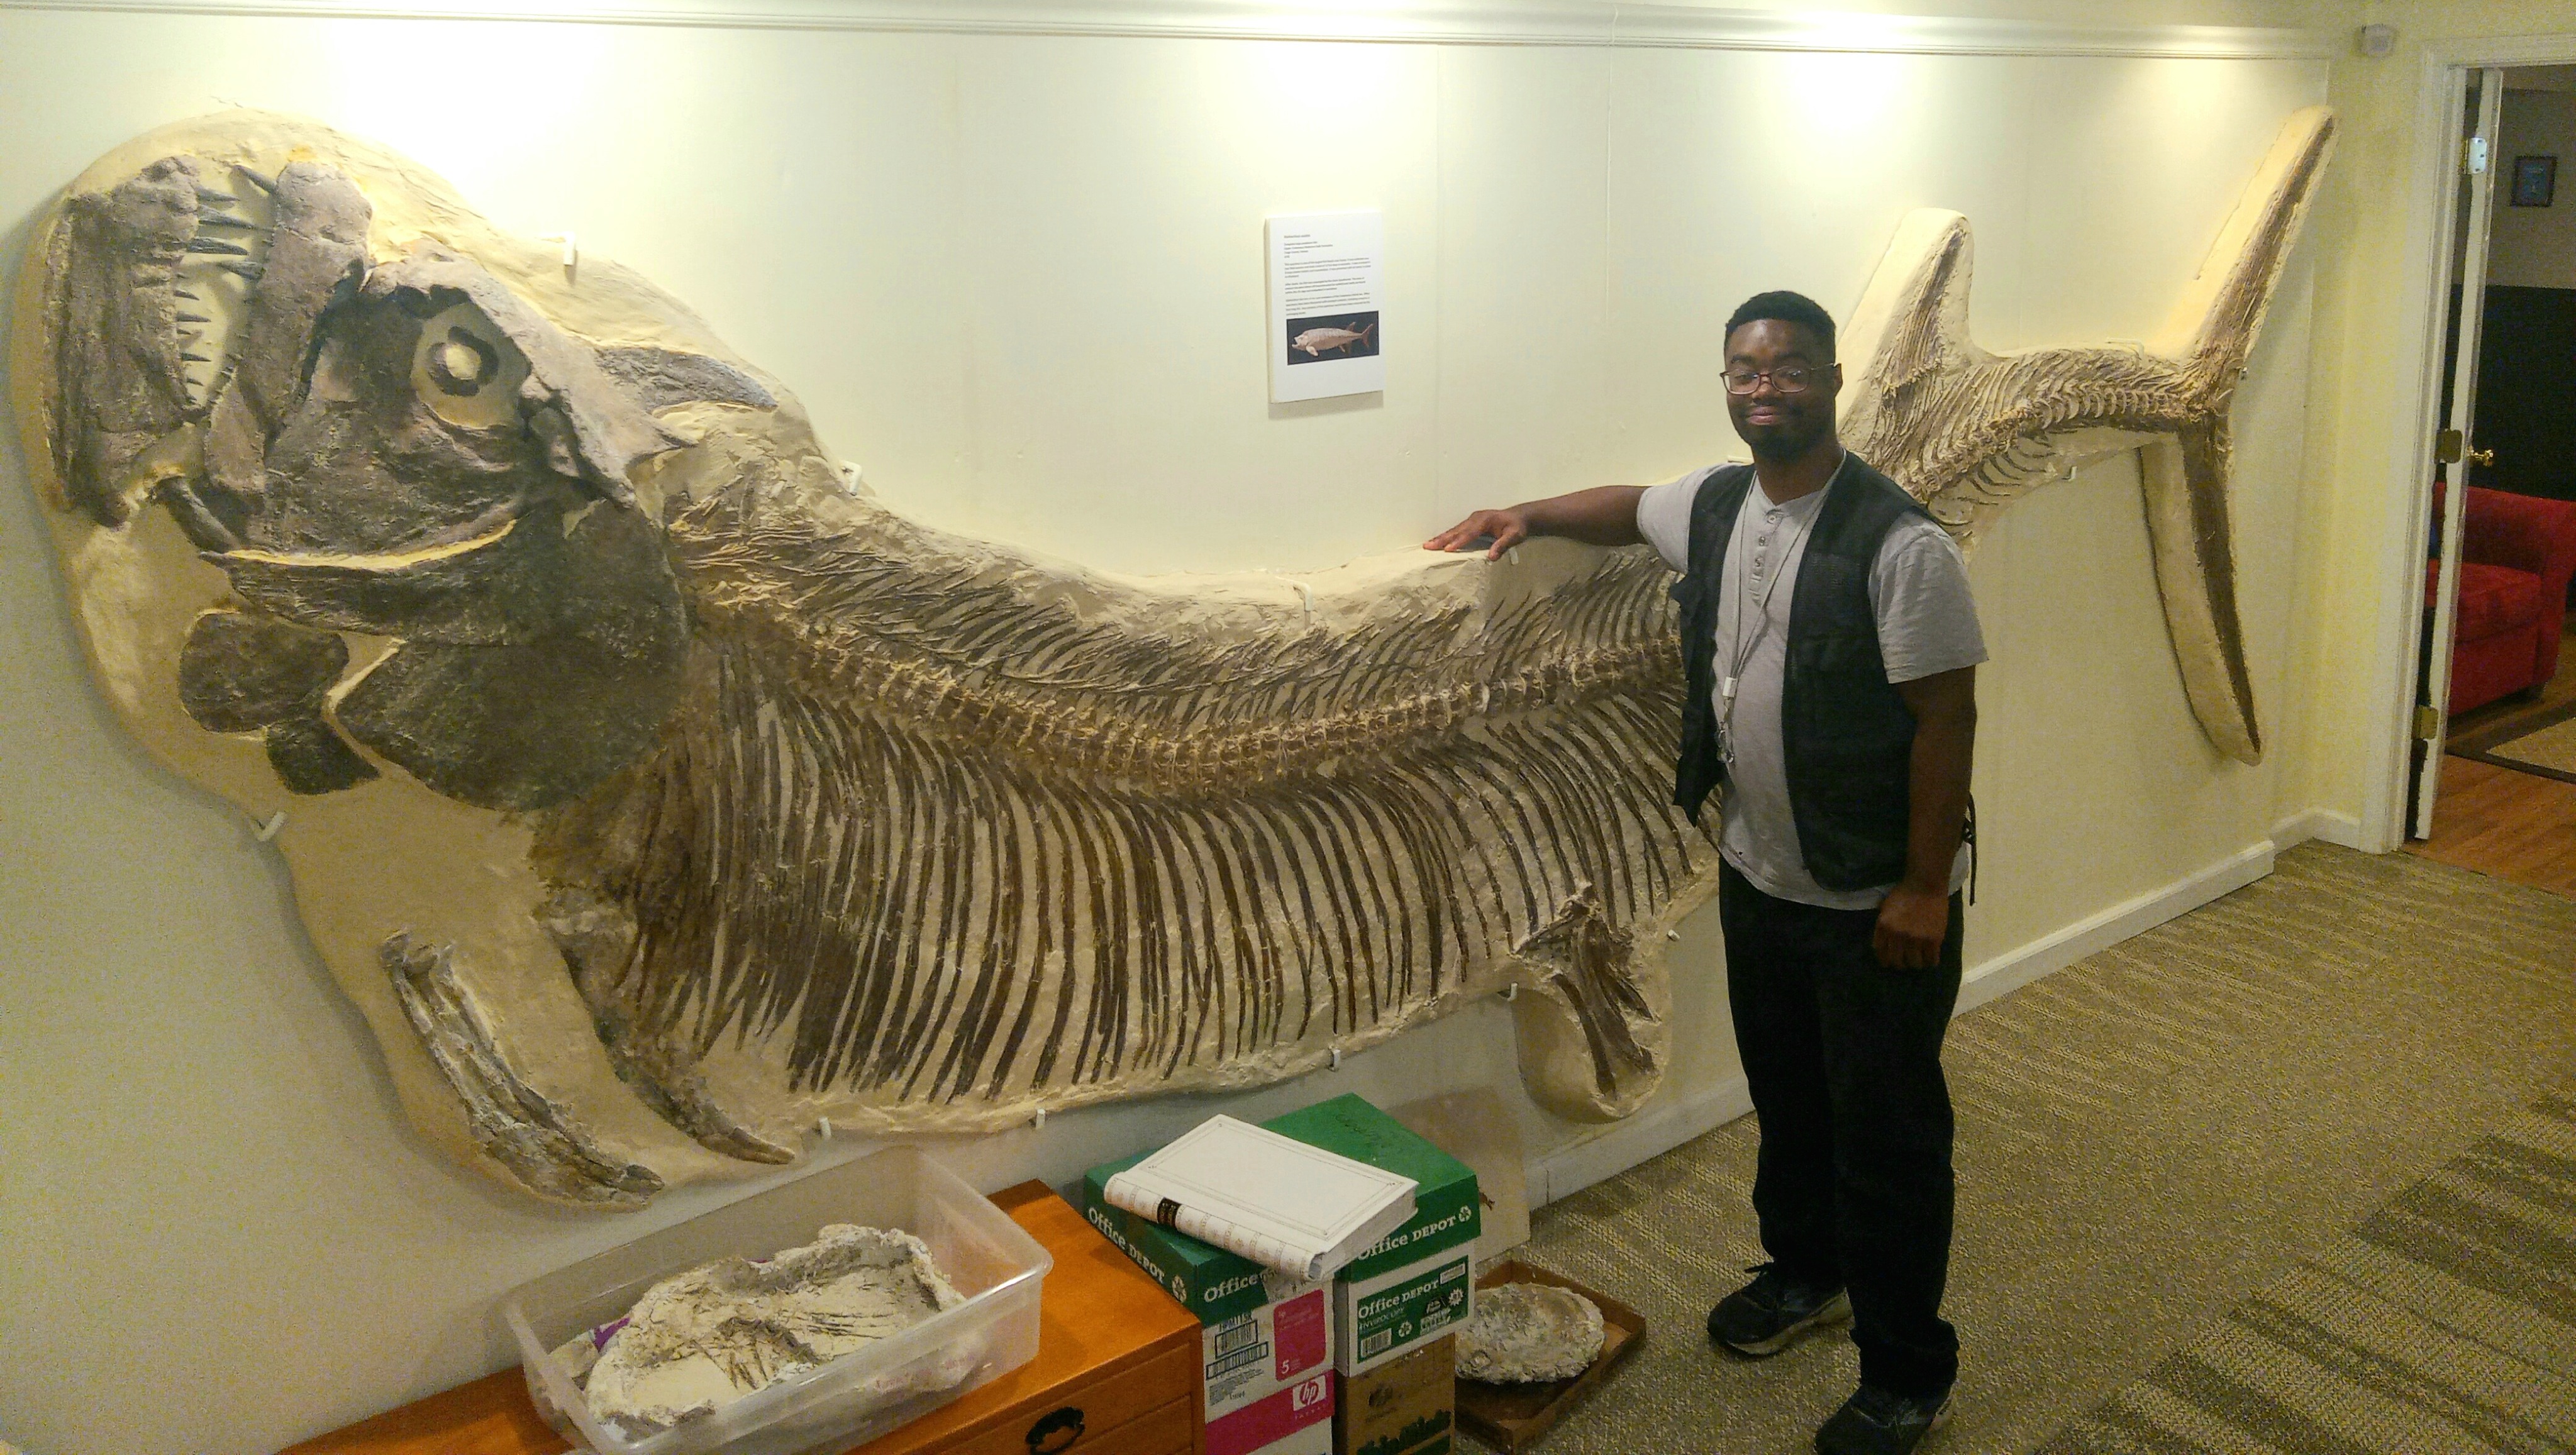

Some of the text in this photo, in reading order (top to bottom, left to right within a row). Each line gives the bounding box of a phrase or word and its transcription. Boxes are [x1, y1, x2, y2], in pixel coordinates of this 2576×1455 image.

[1413, 1215, 1456, 1242] DEPOT
[1089, 1207, 1126, 1250] Office
[1128, 1244, 1165, 1284] DEPOT
[1204, 1274, 1258, 1302] Office
[1358, 1298, 1400, 1319] Office
[1402, 1279, 1439, 1302] DEPOT
[1282, 1359, 1289, 1375] 5
[1302, 1382, 1317, 1405] hp
